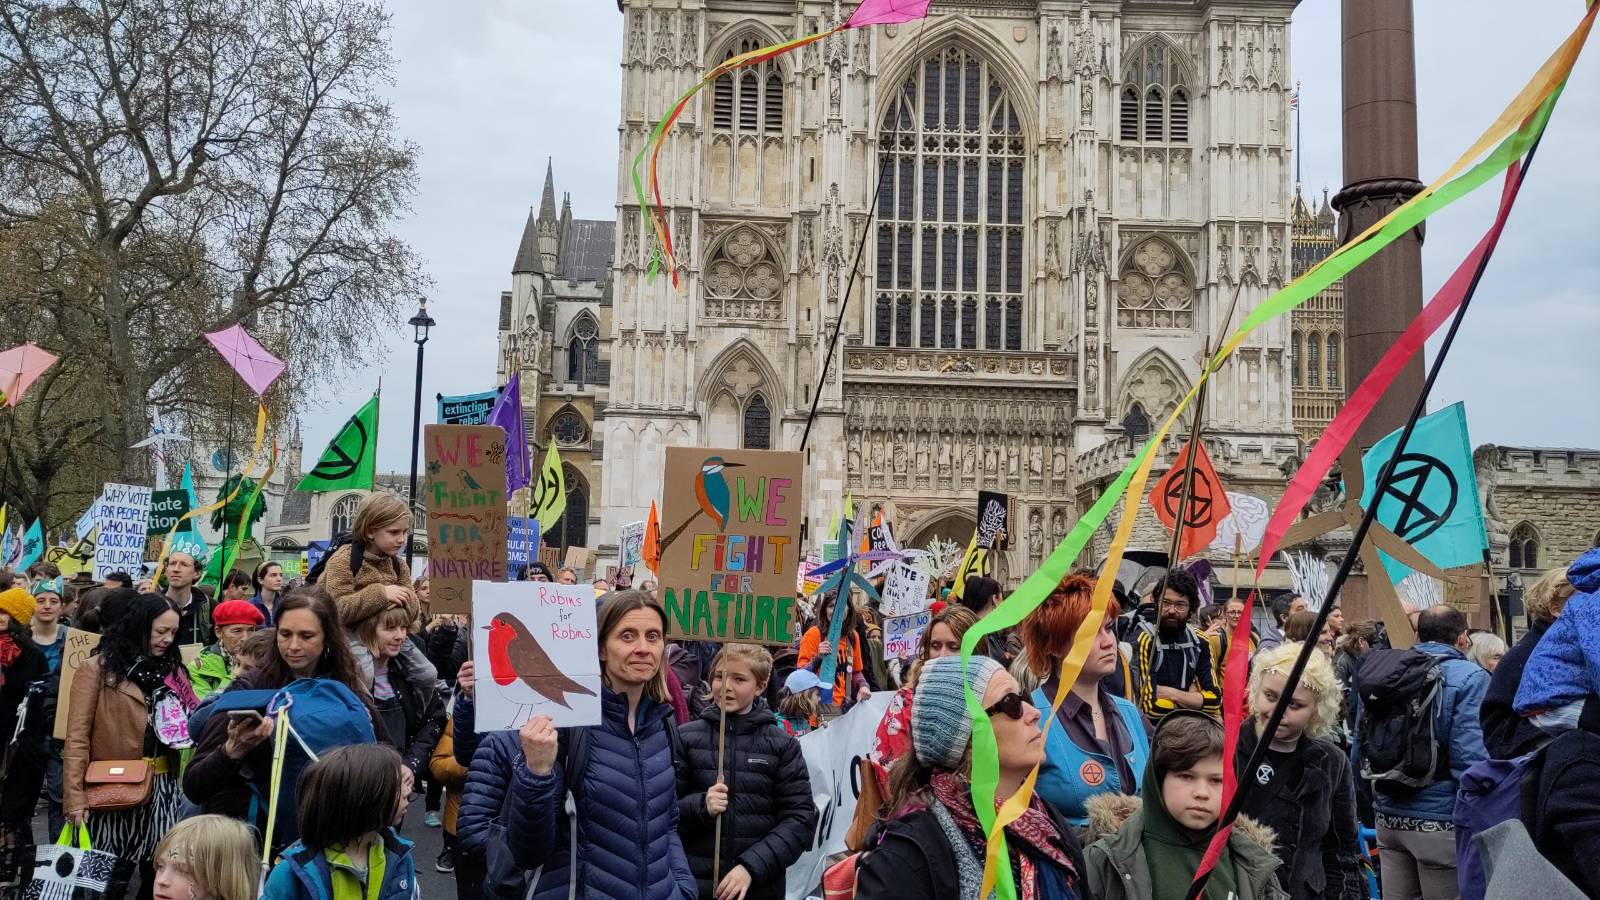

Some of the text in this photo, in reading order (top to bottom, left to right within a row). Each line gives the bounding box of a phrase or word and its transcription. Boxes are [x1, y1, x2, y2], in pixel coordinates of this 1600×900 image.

[445, 401, 489, 415] extinction
[434, 433, 482, 468] WE
[105, 488, 151, 506] WHY VOTE
[432, 481, 501, 508] FIGHT
[737, 477, 792, 526] WE
[101, 505, 115, 518] FOR
[117, 506, 149, 522] PEOPLE
[101, 519, 123, 533] WHO
[125, 521, 144, 535] WILL
[147, 515, 178, 530] tion
[97, 533, 144, 548] CAUSE YOUR
[438, 523, 482, 544] FOR
[511, 528, 534, 536] POVETY
[96, 548, 144, 565] CHILDREN
[431, 559, 501, 579] NATURE
[710, 574, 753, 593] FOR
[540, 587, 582, 607] Robins
[559, 608, 572, 622] for
[664, 587, 796, 643] NATURE
[891, 615, 928, 632] SAY NO
[69, 634, 90, 648] THE
[886, 639, 912, 656] FOSSIL
